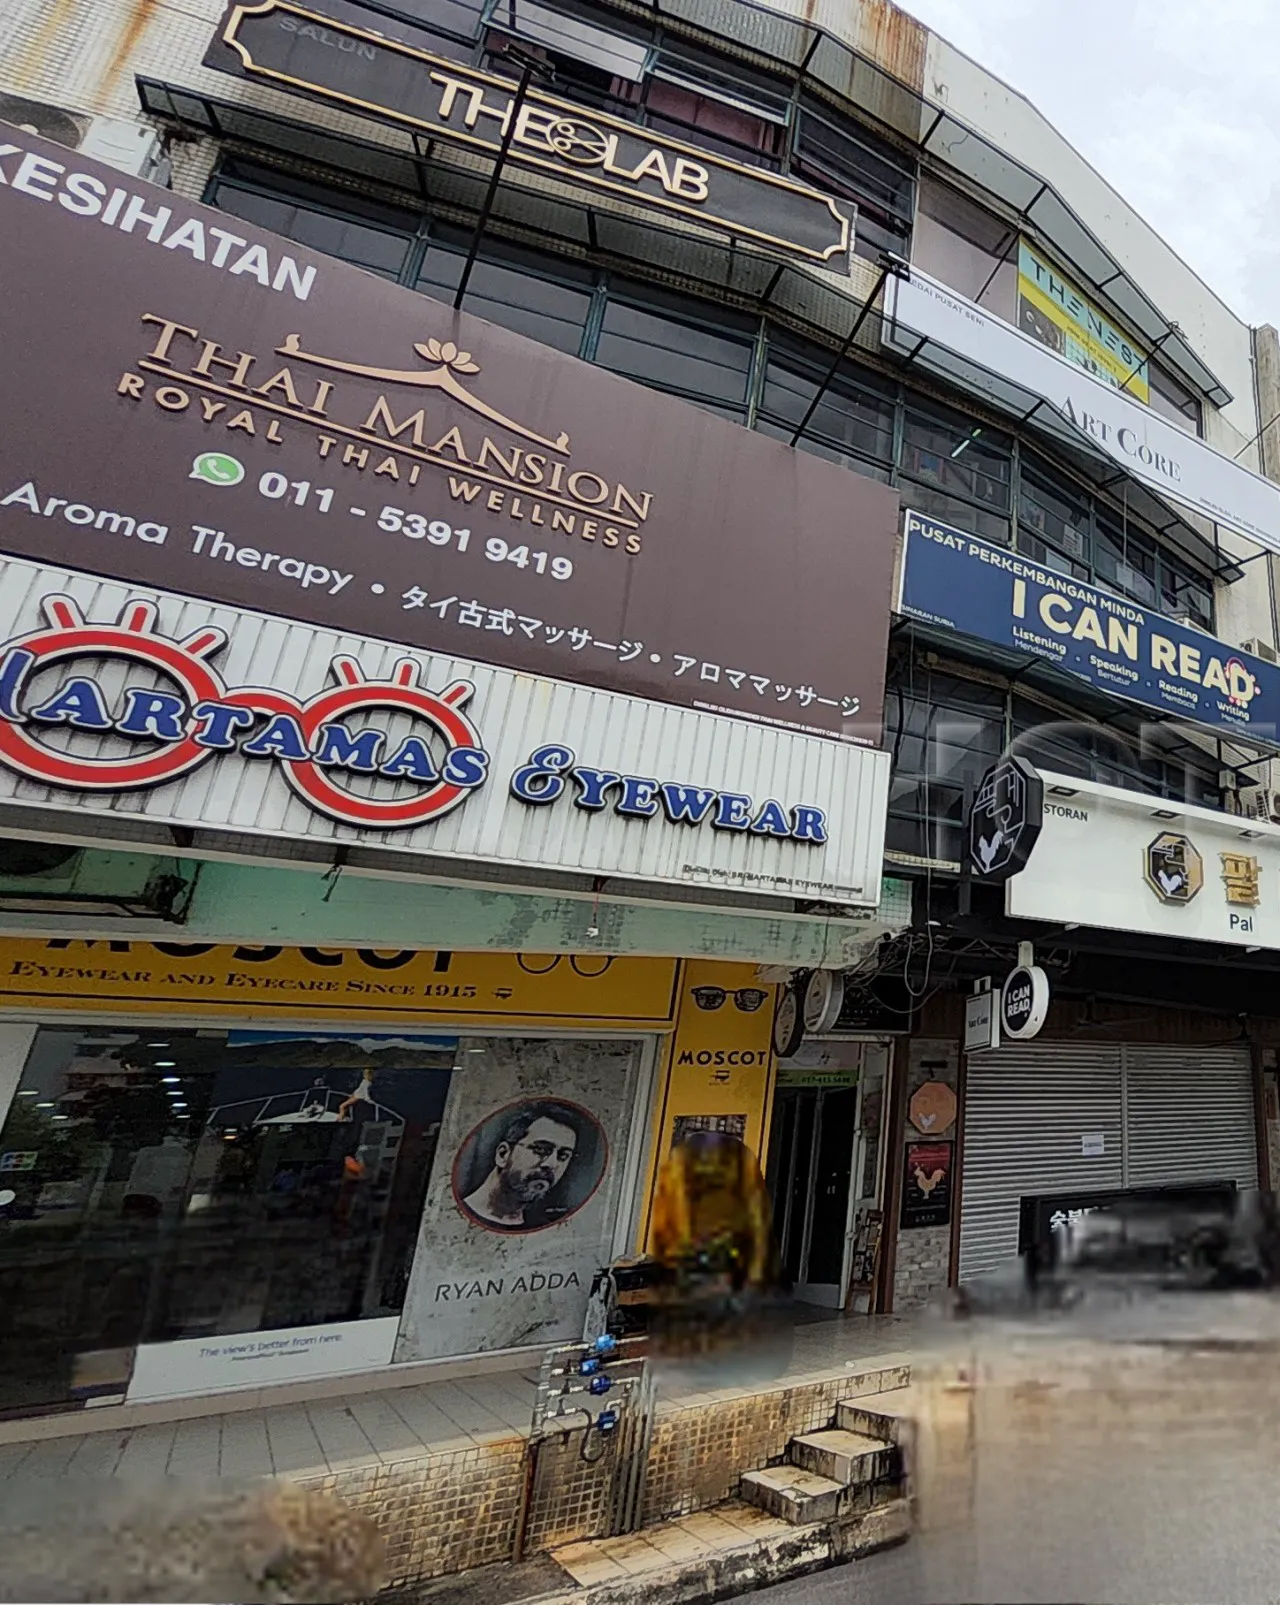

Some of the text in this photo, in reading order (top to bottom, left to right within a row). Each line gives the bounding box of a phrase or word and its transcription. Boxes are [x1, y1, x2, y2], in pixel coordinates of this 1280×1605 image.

[279, 15, 378, 61] SALON
[429, 71, 710, 201] THE LAB
[934, 293, 963, 314] PUSAT
[141, 313, 653, 522] THAI MANSION
[1058, 396, 1182, 483] ART CORE
[117, 372, 642, 554] ROYAL THAI WELLNESS
[2, 481, 355, 596] Aroma Therapy
[258, 471, 335, 513] 011
[376, 505, 469, 552] 5391
[484, 538, 574, 580] 9419
[908, 518, 1145, 626] PUSAT PERKEMBANGAN MINDA
[1012, 578, 1257, 703] I CAN READ
[1014, 638, 1063, 663] Mendengar
[1012, 626, 1067, 655] Listening
[1089, 653, 1139, 682] Speaking
[1158, 679, 1199, 703] Reading
[1216, 700, 1250, 722] Writing
[509, 742, 829, 846] EYEWEAR
[1043, 803, 1089, 823] STORAN
[1229, 913, 1254, 933] Pal
[8, 960, 478, 999] EYEWEAR AND EYECARE SINCE 1915
[1012, 984, 1031, 1002] CAN
[1007, 1000, 1030, 1017] READ
[676, 1050, 767, 1067] MOSCOT
[435, 1271, 581, 1303] RYAN ADDA
[199, 1347, 219, 1358] The
[223, 1344, 255, 1355] view's
[257, 1341, 290, 1351] better
[293, 1337, 317, 1347] from
